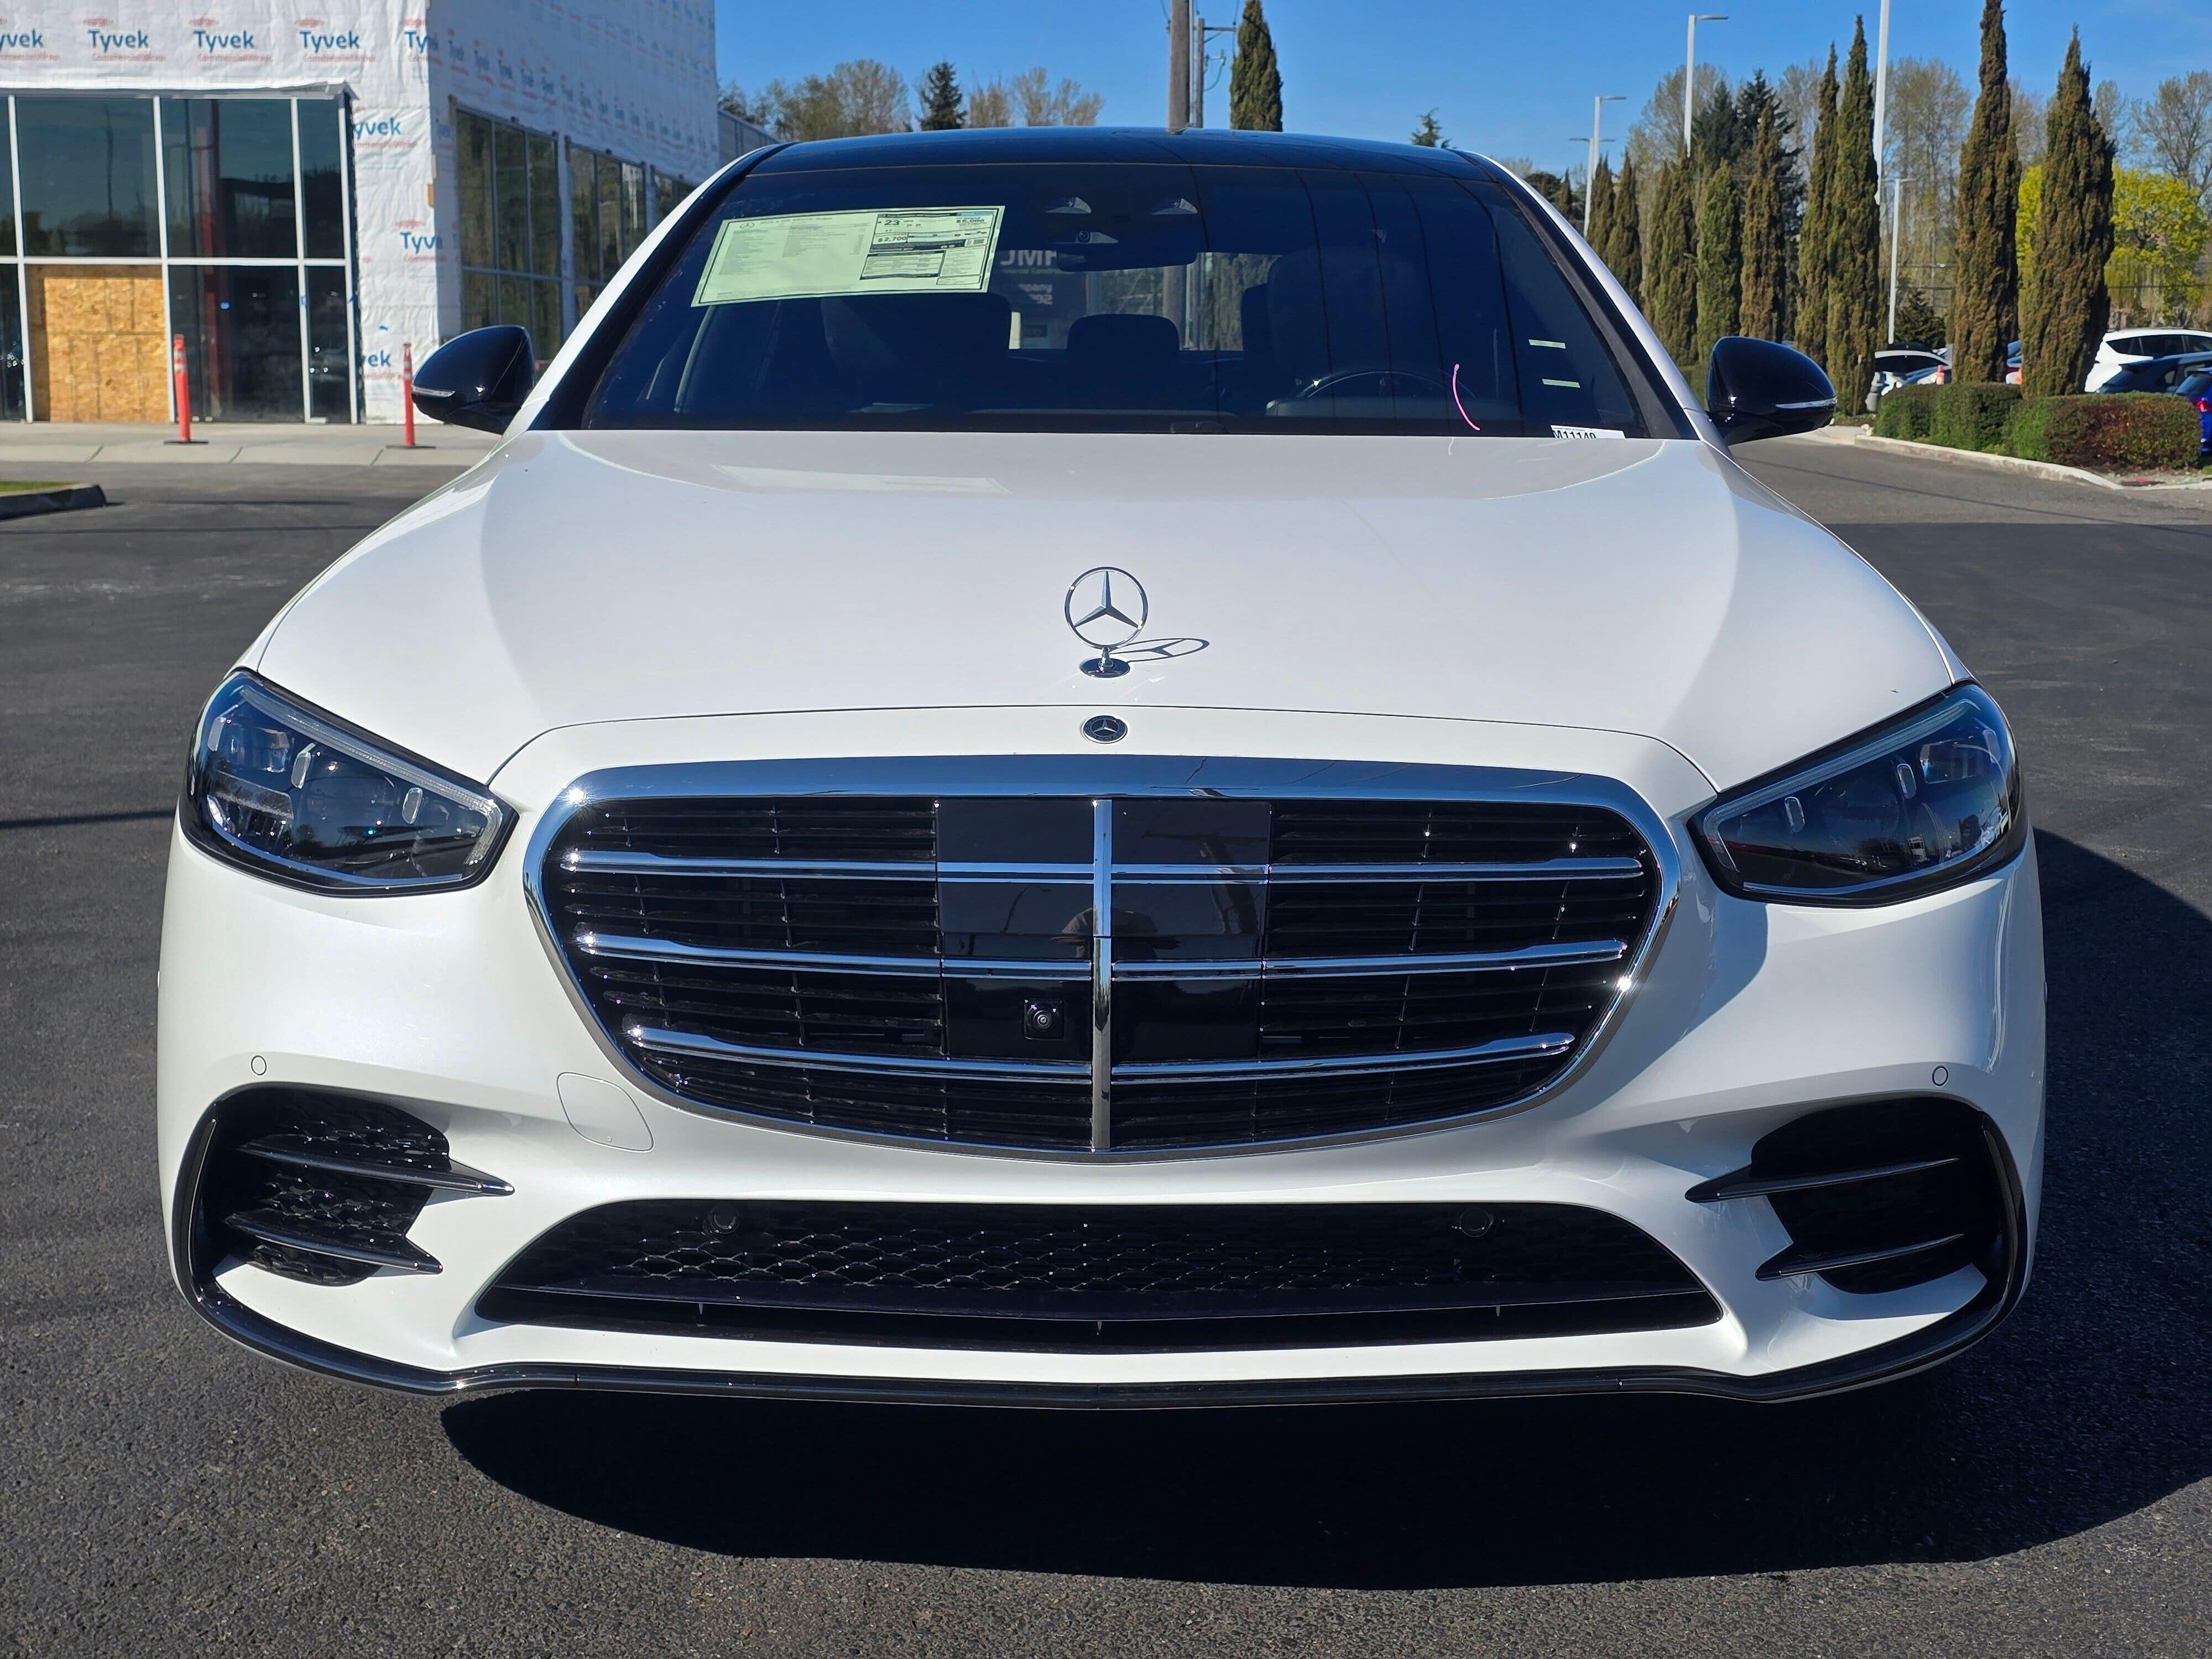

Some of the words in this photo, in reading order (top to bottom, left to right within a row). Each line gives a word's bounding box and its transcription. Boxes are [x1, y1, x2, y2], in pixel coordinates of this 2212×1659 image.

[87, 28, 149, 53] Tyvek
[193, 29, 254, 53] Tyvek
[299, 30, 360, 54] Tyvek
